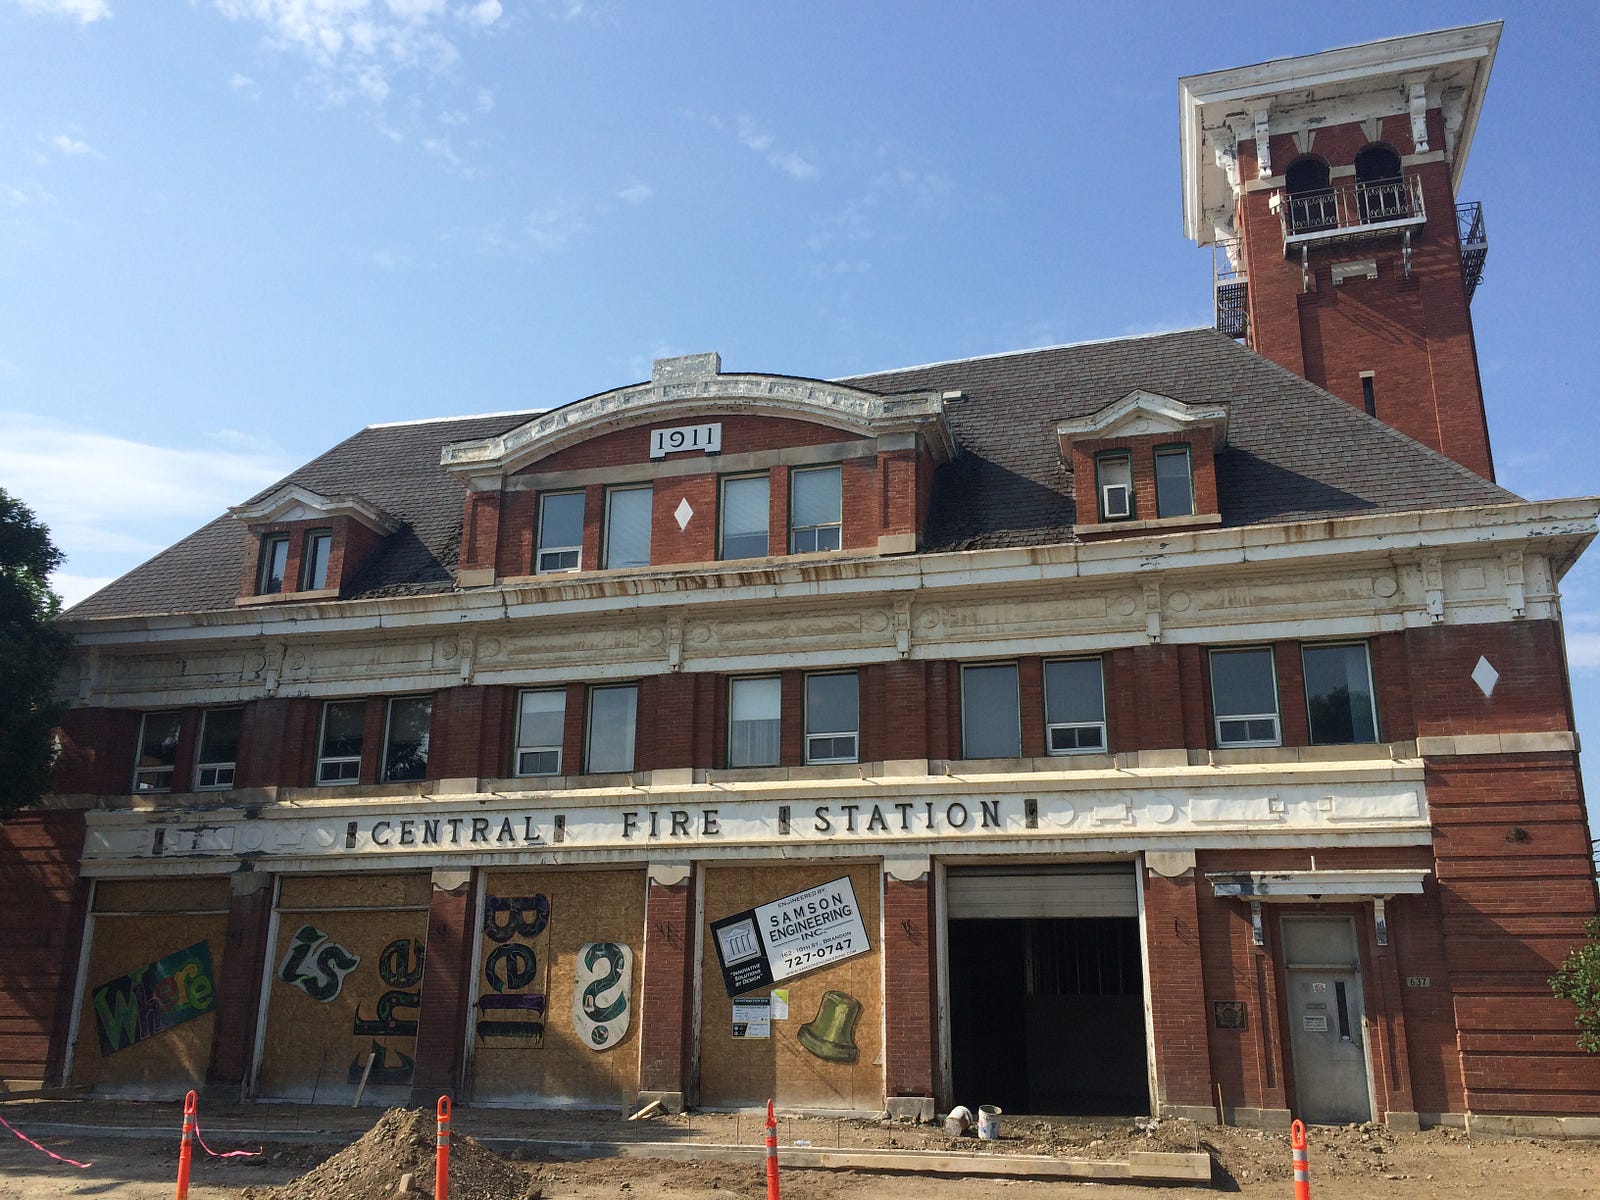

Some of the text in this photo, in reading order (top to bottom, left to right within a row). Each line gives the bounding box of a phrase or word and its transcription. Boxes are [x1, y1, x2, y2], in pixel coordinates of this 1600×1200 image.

[658, 427, 713, 450] 1911
[371, 800, 1000, 846] CENTRAL FIRE STATION
[770, 892, 843, 927] SAMSON
[778, 891, 817, 908] ENGINEERED
[769, 905, 852, 942] ENGINEERING
[801, 928, 827, 941] INC.
[823, 931, 852, 944] BRANDON
[283, 926, 358, 1001] is
[785, 938, 852, 968] 727-0747
[476, 893, 550, 1048] Bell
[1410, 977, 1427, 986] 637
[94, 964, 213, 1051] Where
